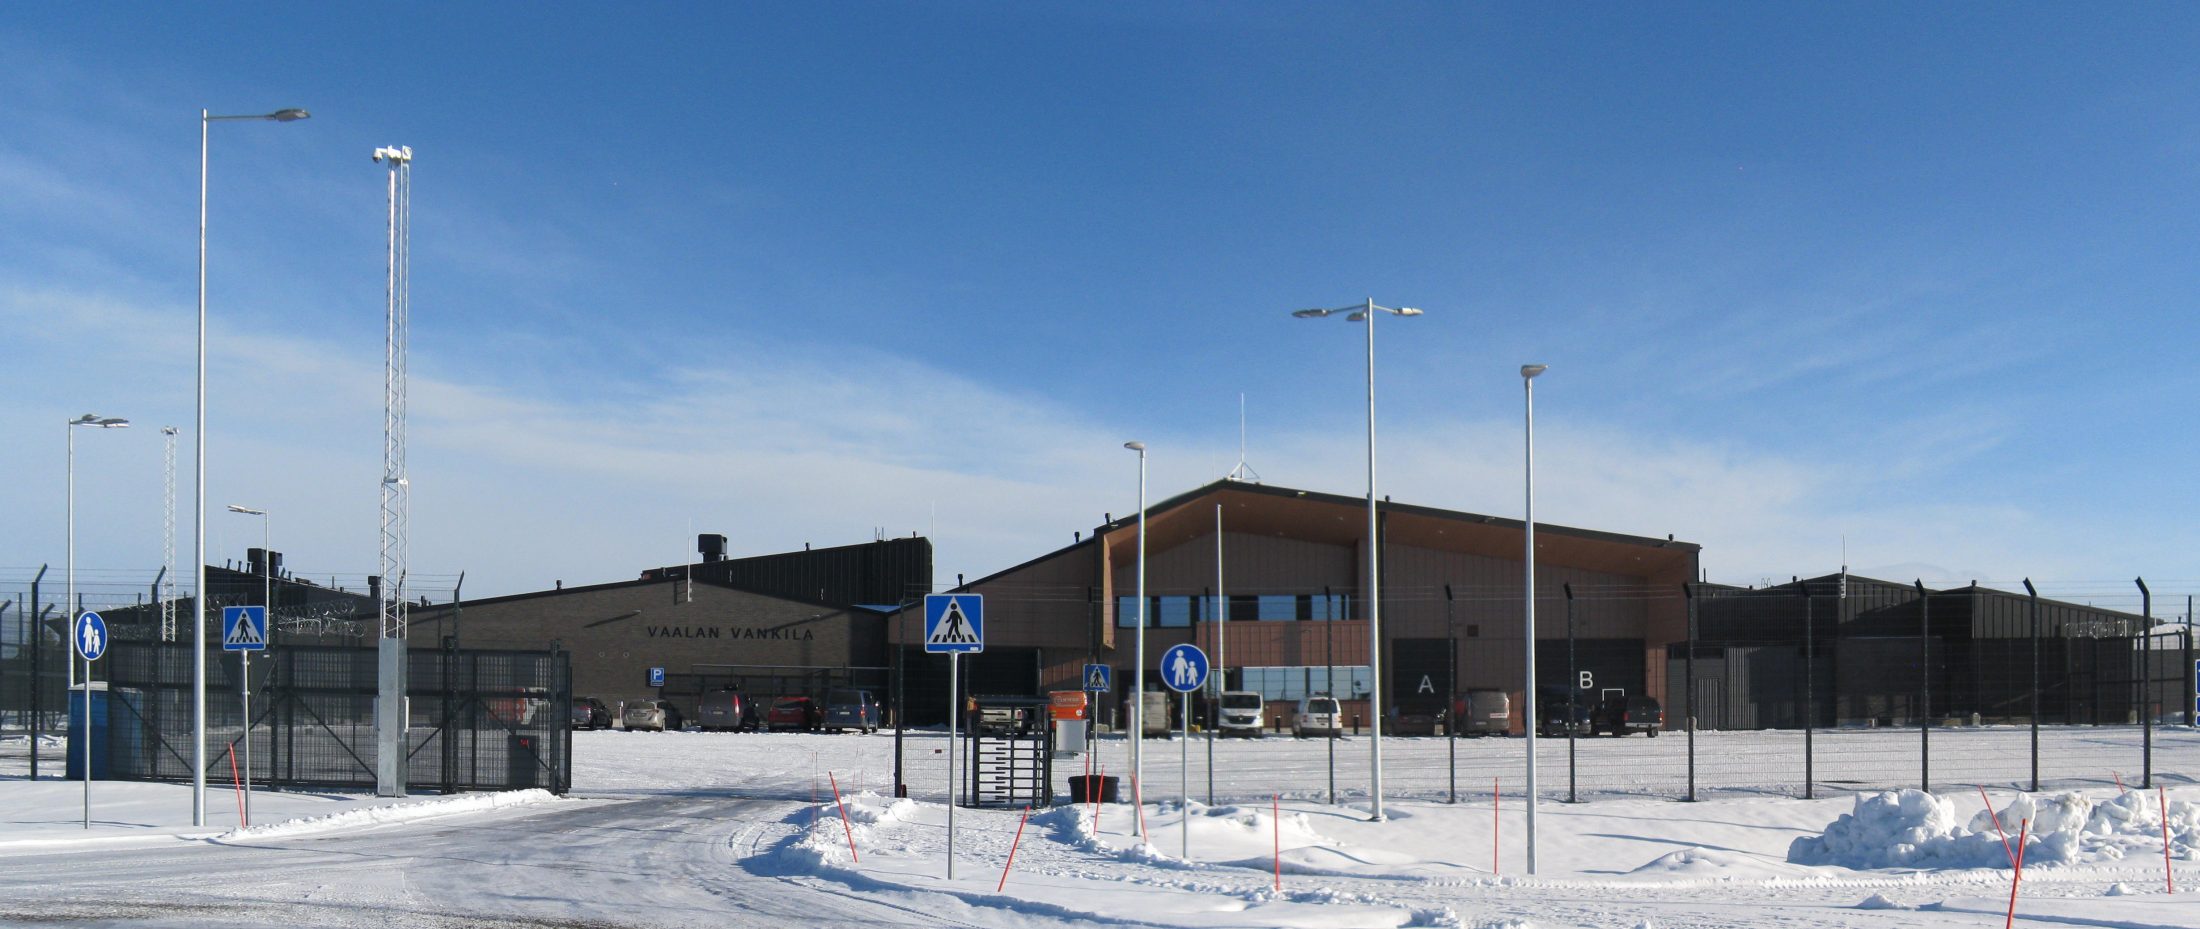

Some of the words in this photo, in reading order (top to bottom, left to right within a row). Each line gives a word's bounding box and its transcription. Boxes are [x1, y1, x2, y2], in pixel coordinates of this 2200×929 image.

[648, 626, 719, 639] VAALAN
[731, 627, 814, 641] VANKILA
[653, 669, 662, 680] P
[1579, 670, 1594, 690] B
[1417, 674, 1435, 694] A
